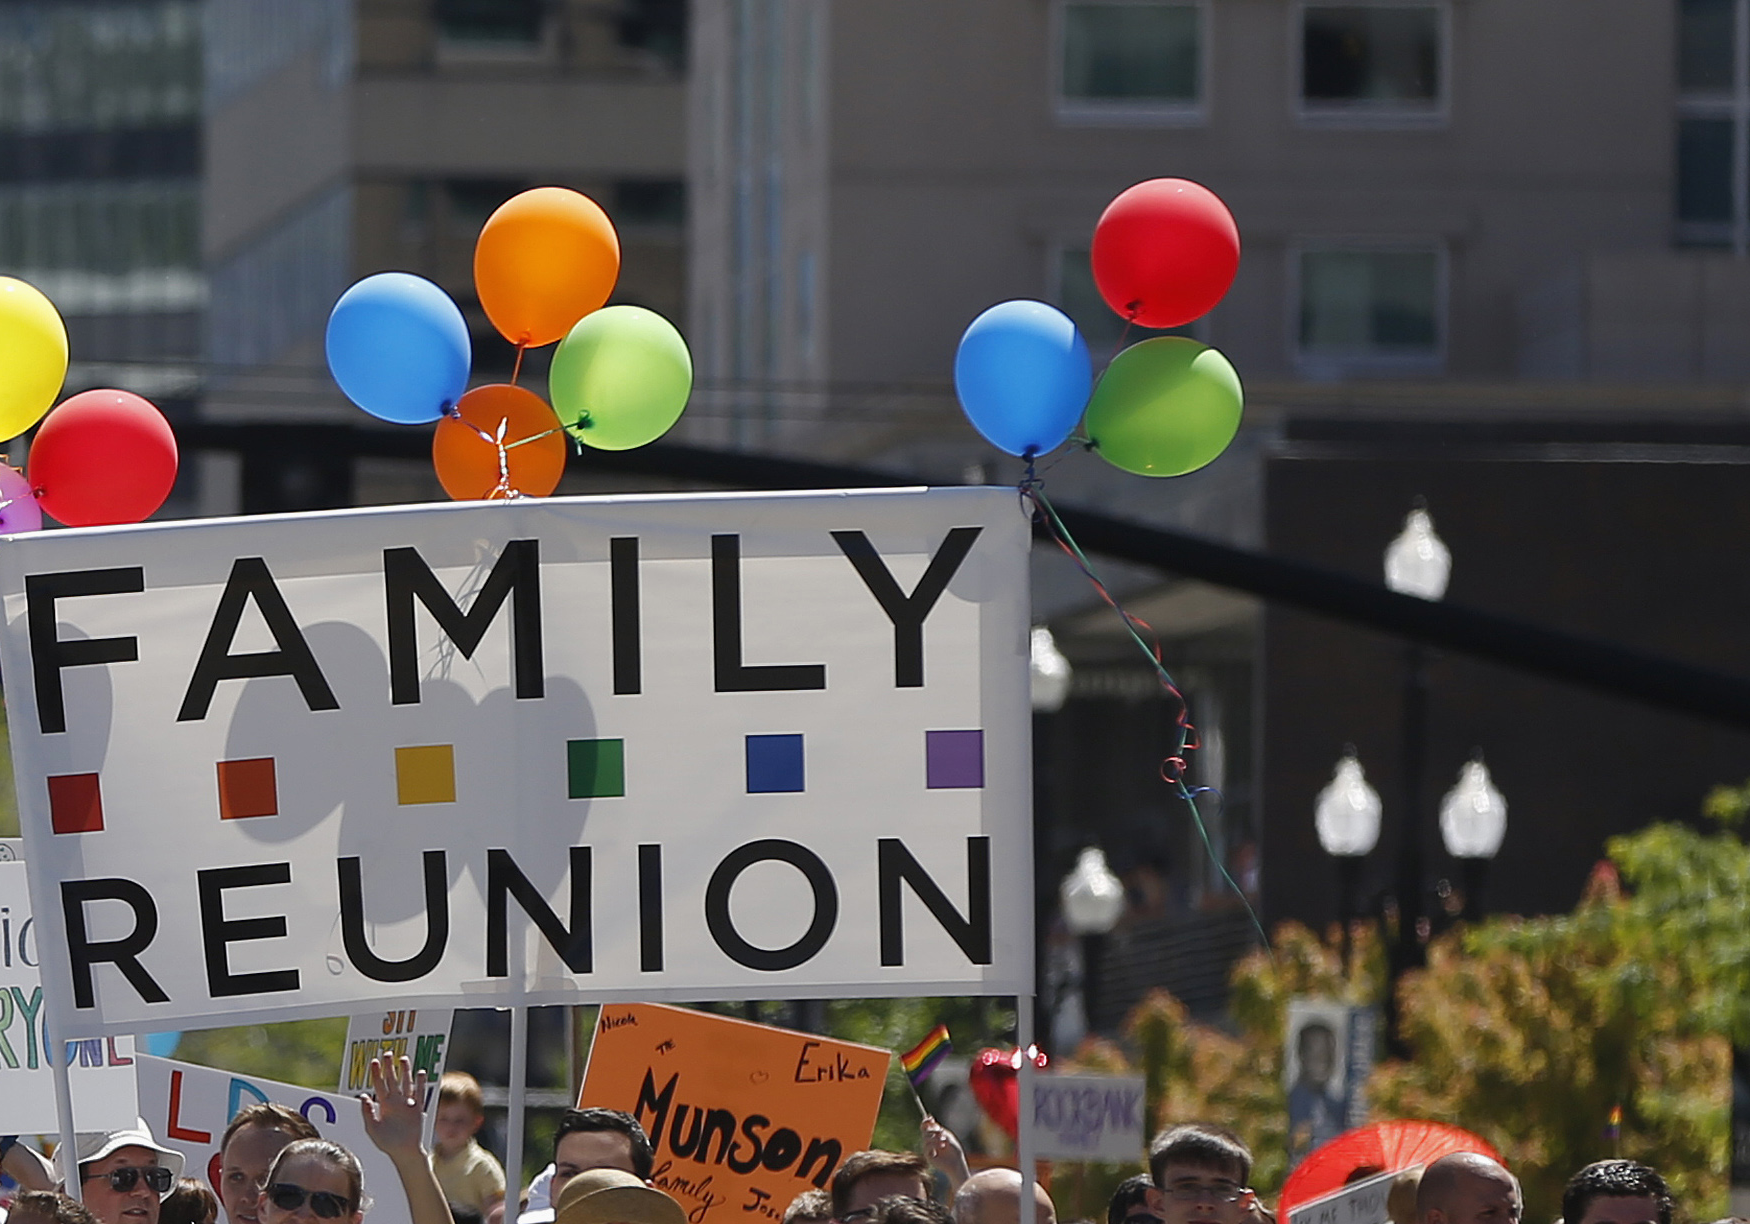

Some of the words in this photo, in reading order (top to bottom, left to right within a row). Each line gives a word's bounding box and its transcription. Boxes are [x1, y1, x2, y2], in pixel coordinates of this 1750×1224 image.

[24, 526, 983, 733] FAMILY
[60, 836, 992, 1009] REUNION
[634, 1066, 842, 1188] Munson
